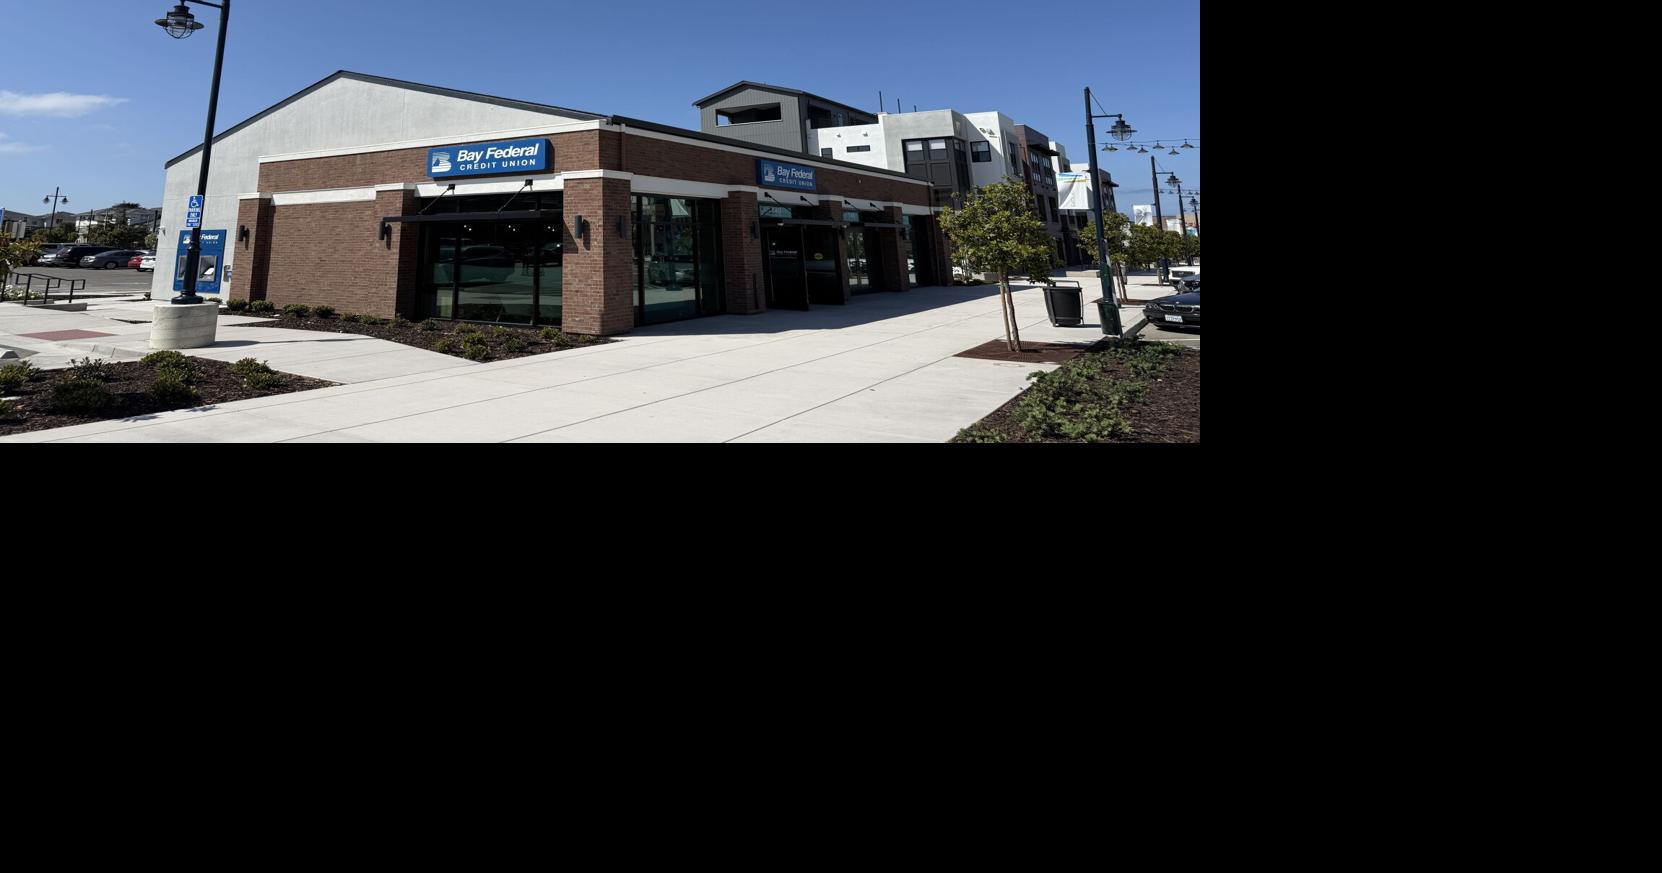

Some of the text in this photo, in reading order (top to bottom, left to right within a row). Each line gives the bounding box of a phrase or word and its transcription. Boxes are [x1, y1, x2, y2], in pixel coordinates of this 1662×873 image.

[457, 143, 539, 163] Bay Federal
[460, 159, 536, 171] CREDIT UNION
[777, 166, 813, 180] Bay Federal
